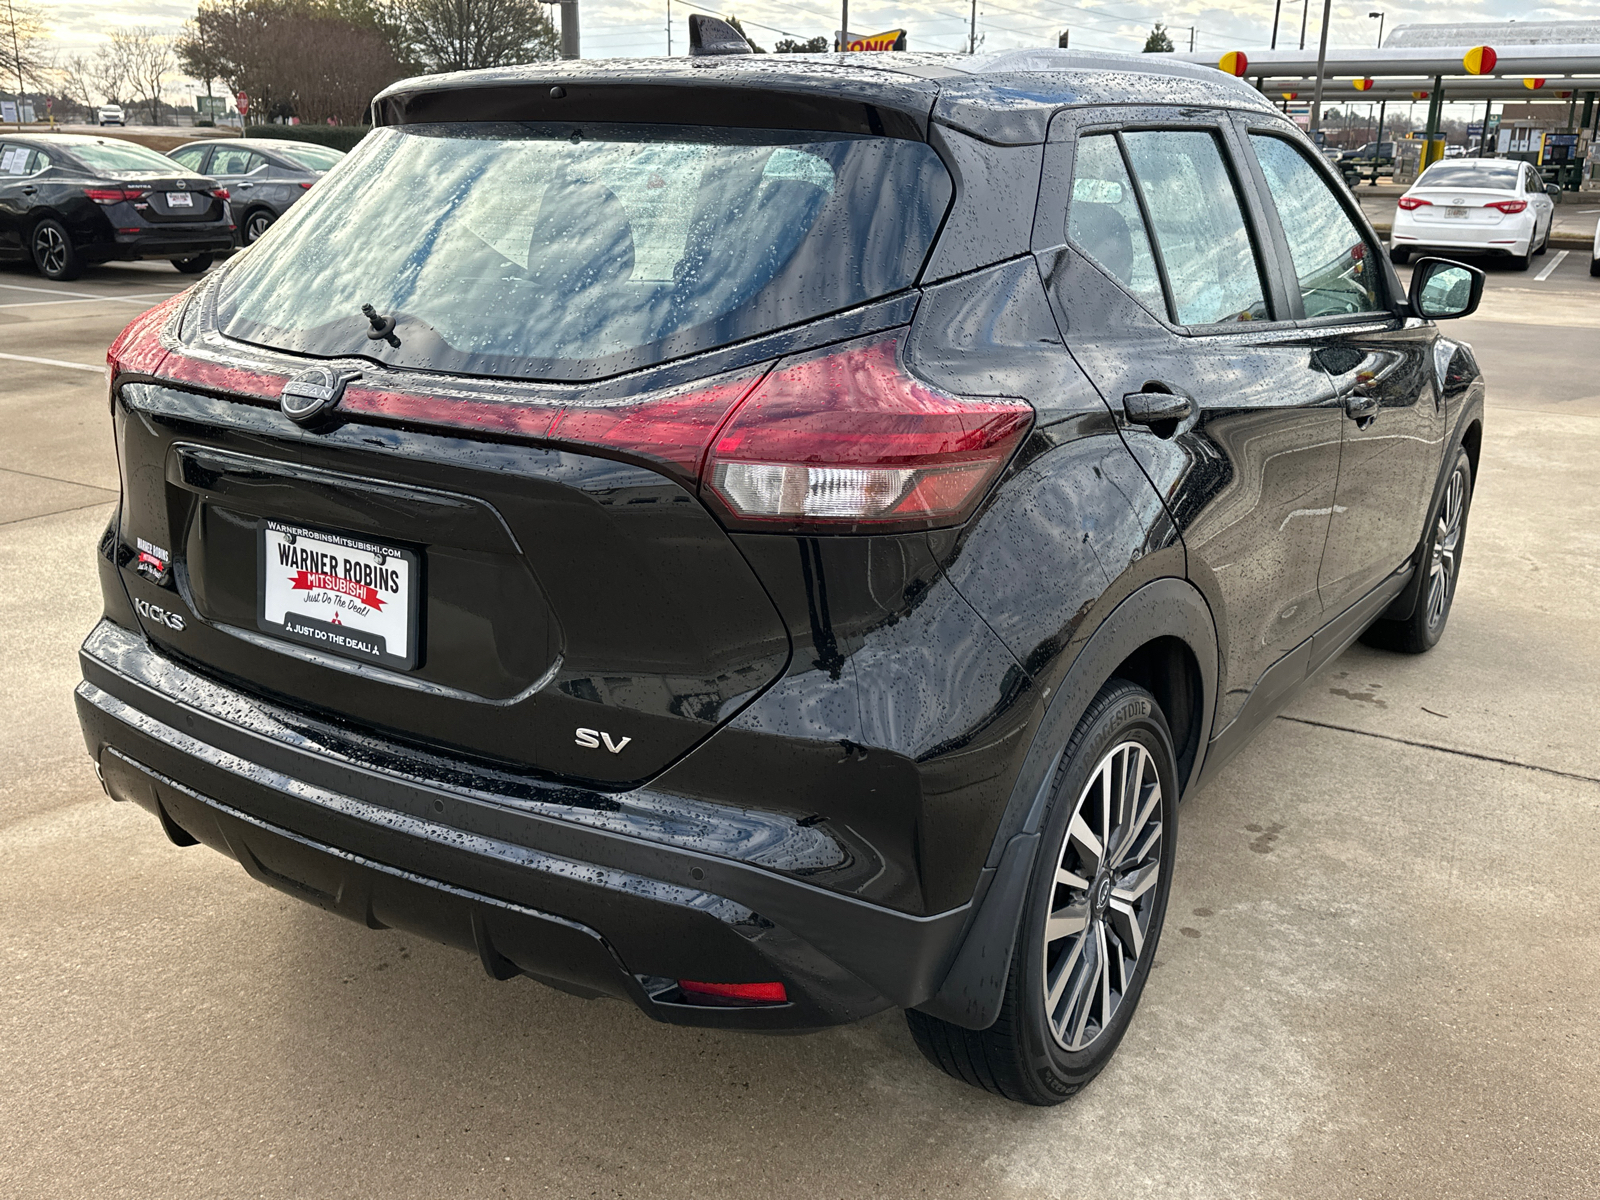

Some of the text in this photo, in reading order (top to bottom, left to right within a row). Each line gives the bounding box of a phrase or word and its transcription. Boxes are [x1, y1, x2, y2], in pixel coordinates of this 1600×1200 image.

[842, 39, 896, 51] ONIC
[277, 542, 399, 594] WARNER ROBINS
[307, 573, 367, 600] MITSUBISHI
[135, 597, 187, 632] KICKS
[303, 591, 370, 617] Just Do The Deal!
[293, 624, 371, 652] JUST DO THE DEAL!
[574, 727, 632, 754] SV
